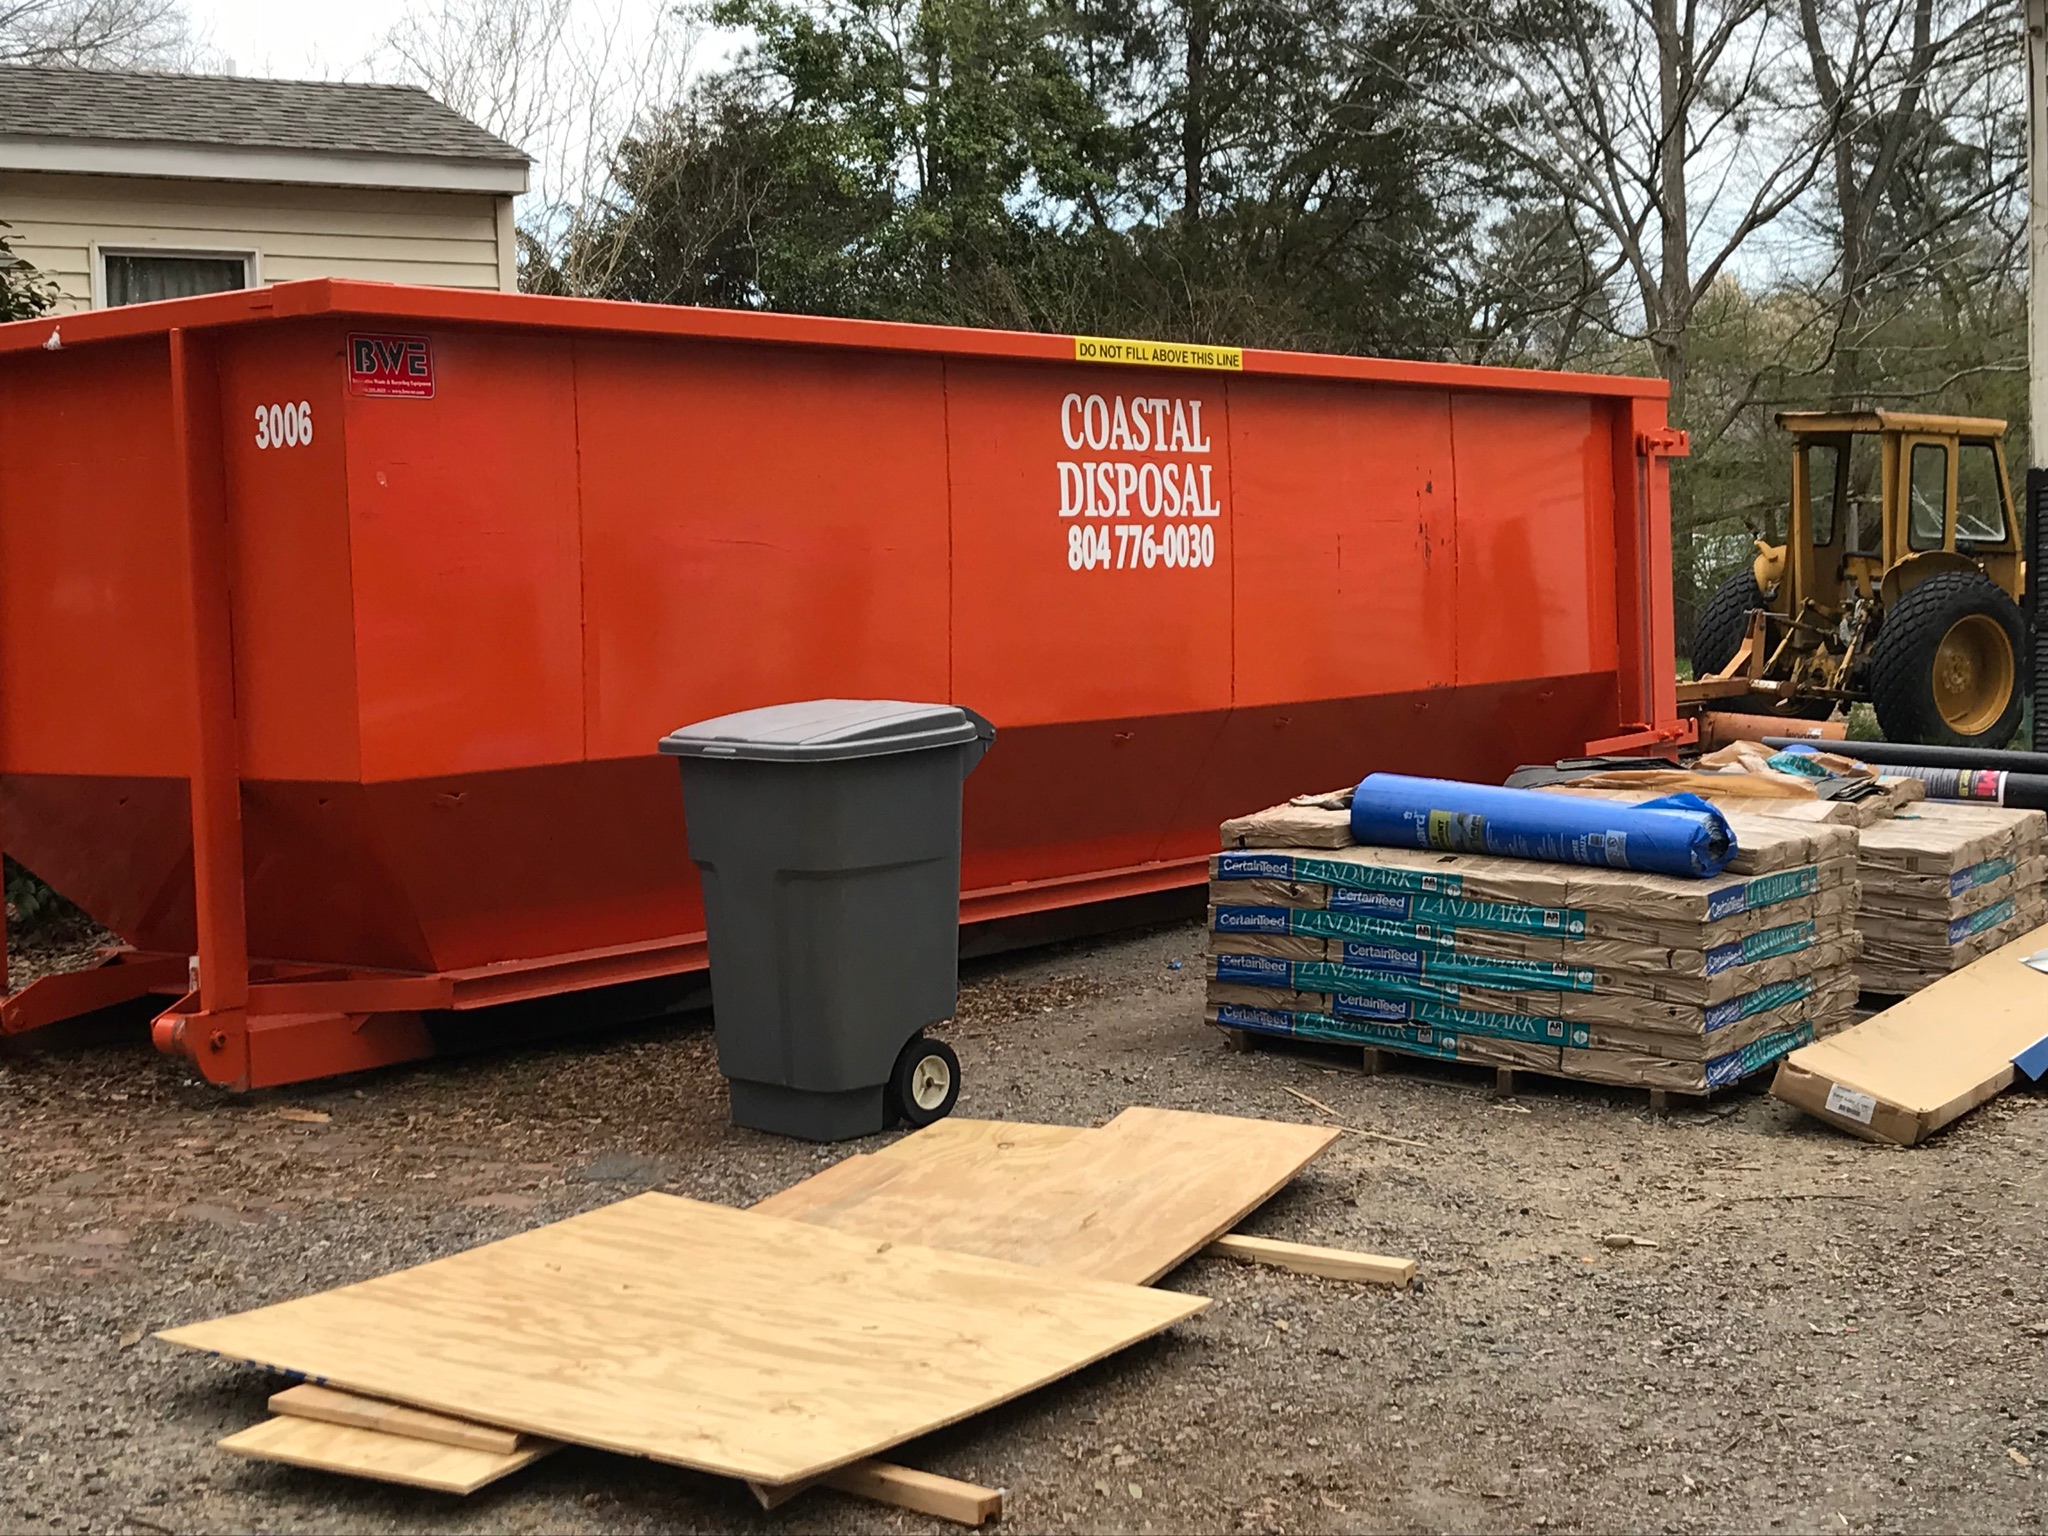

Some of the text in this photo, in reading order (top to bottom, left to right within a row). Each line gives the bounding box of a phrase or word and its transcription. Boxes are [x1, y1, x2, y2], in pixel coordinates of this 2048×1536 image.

[352, 338, 428, 376] BWE
[1079, 342, 1240, 367] DO NOT FILL ABOVE THIS LINE
[254, 400, 313, 449] 3006
[1061, 393, 1211, 453] COASTAL
[1056, 461, 1221, 518] DISPOSAL
[1067, 523, 1215, 571] 804 776-0030
[1222, 858, 1288, 875] CertainTeed
[1302, 860, 1414, 889] LANDMARK
[1220, 913, 1285, 927] CertainTeed
[1338, 887, 1405, 908] CertainTeed
[1419, 896, 1532, 925] LANDMARK
[1221, 955, 1287, 972] CertainTeed
[1348, 943, 1418, 962] CertainTeed
[1420, 1002, 1537, 1034] LANDMARK
